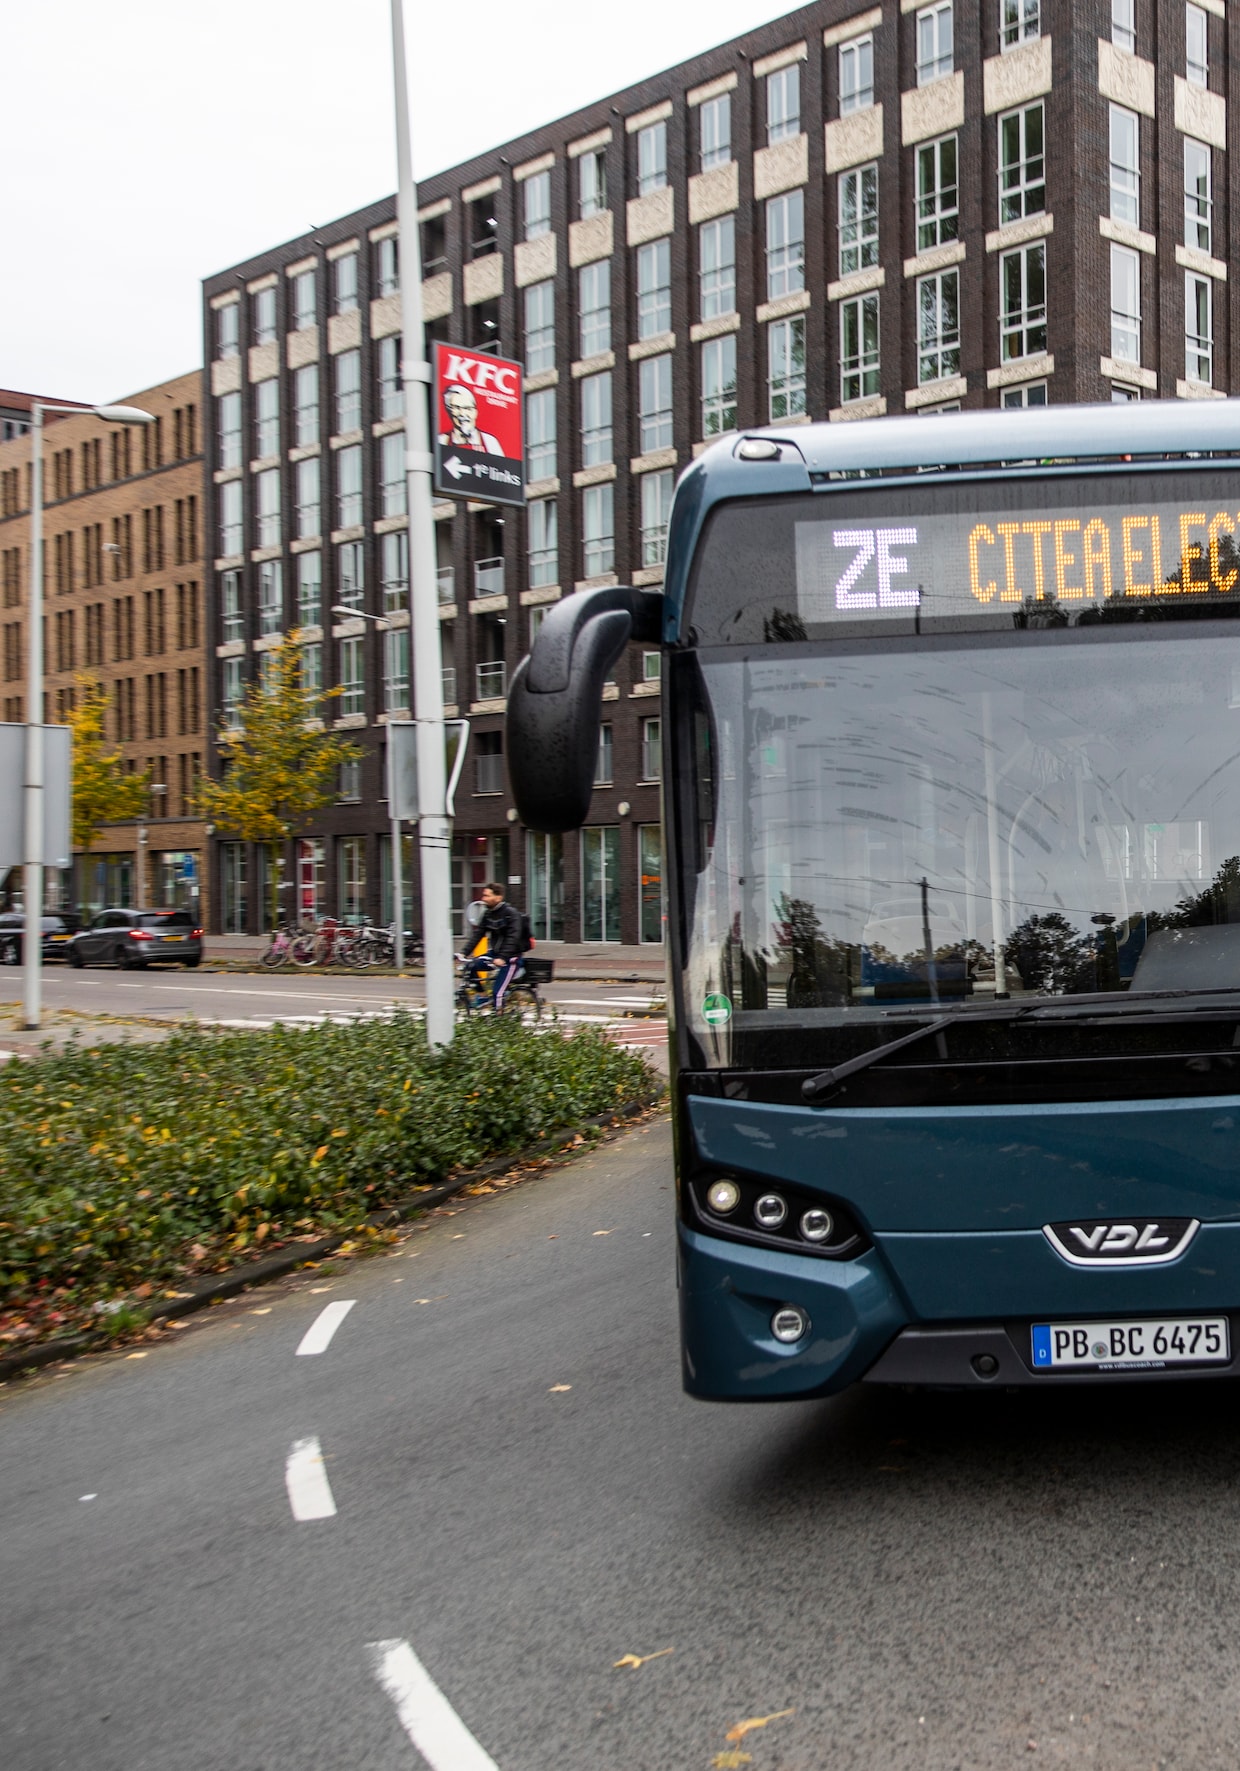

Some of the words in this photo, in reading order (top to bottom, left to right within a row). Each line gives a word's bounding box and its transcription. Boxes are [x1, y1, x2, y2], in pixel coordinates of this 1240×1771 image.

[443, 354, 518, 395] KFC
[489, 466, 521, 486] links
[833, 527, 920, 609] ZE
[968, 518, 1112, 603] CITEA
[1069, 1223, 1170, 1251] VDL
[1038, 1348, 1047, 1359] D
[1054, 1329, 1089, 1359] PB
[1109, 1327, 1145, 1358] BC
[1152, 1324, 1221, 1354] 6475
